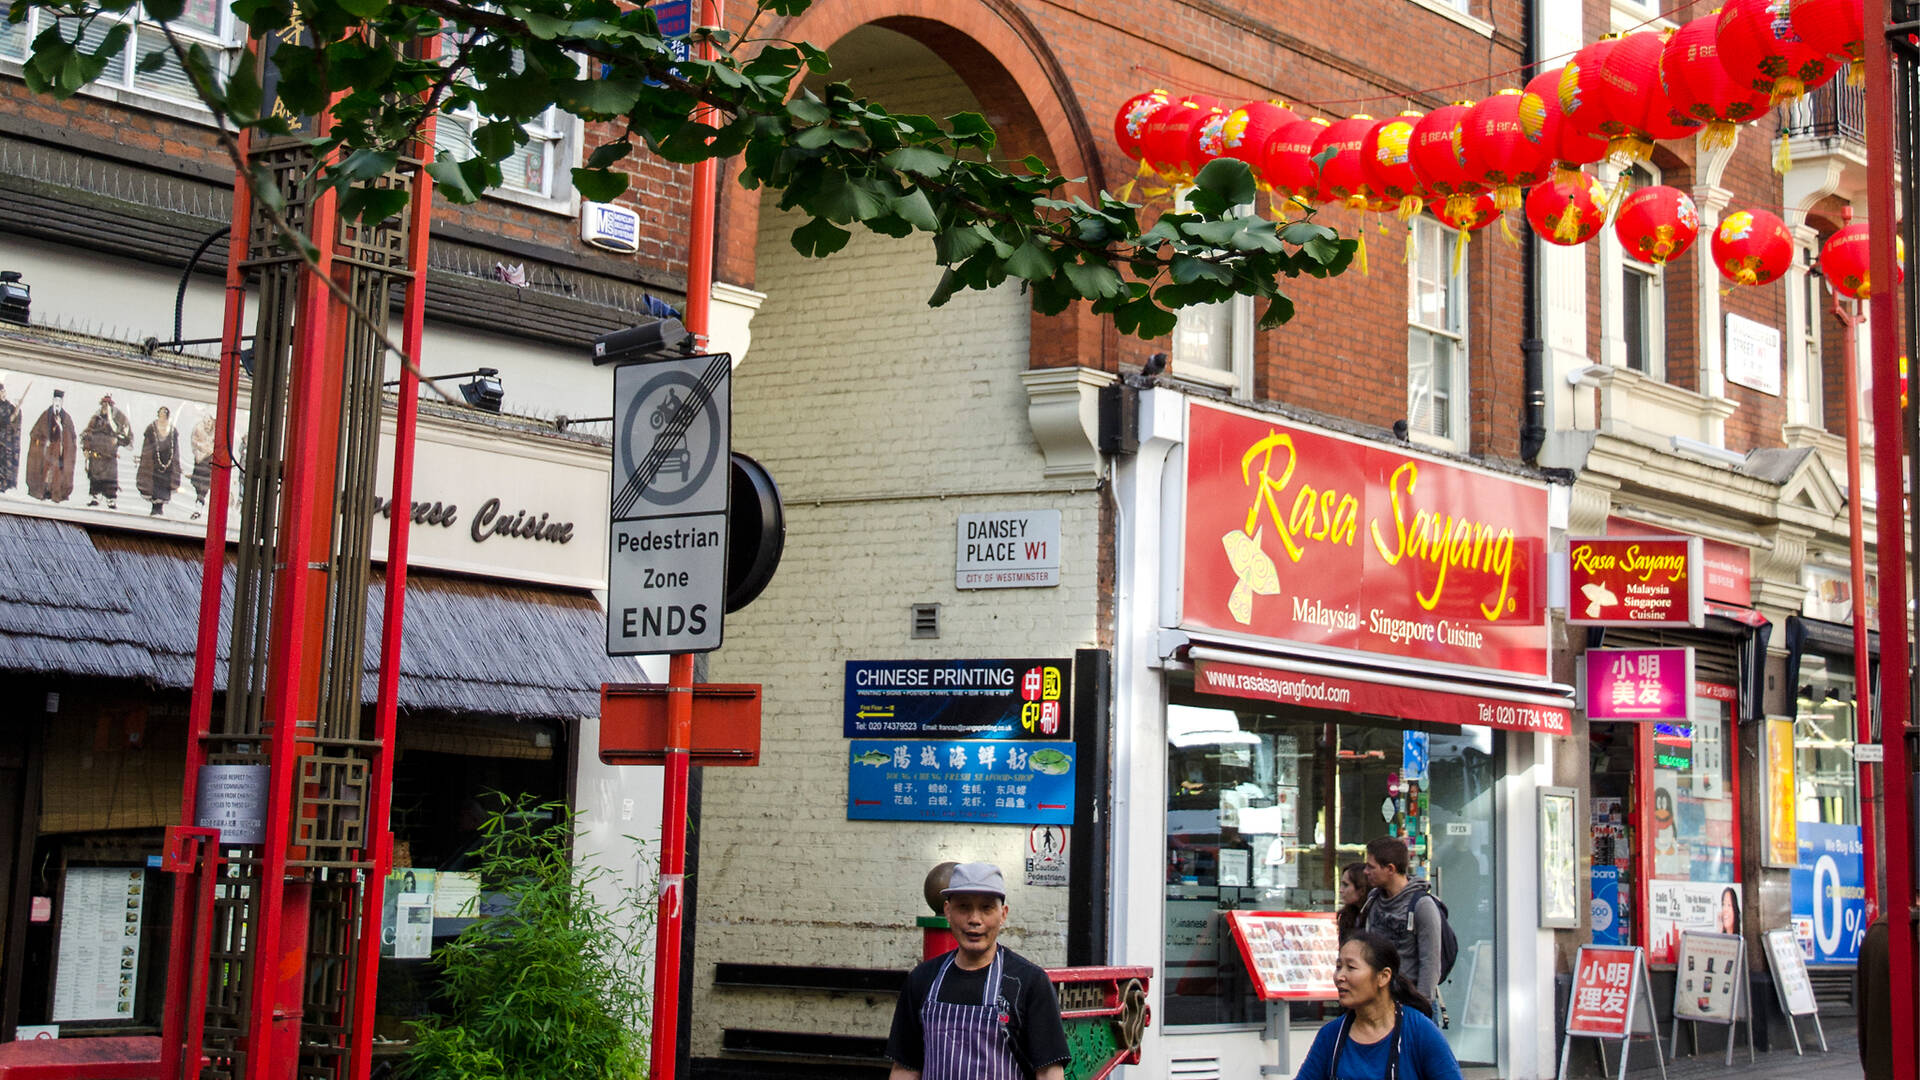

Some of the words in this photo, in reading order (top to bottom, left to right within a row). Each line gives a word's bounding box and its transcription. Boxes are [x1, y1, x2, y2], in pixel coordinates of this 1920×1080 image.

[471, 498, 574, 544] Cuisine
[967, 519, 1028, 539] DANSEY
[1241, 428, 1359, 562] Rasa
[1370, 461, 1515, 622] Sayang
[618, 527, 719, 552] Pedestrian
[967, 542, 1015, 562] PLACE
[1024, 541, 1046, 560] W1
[1572, 545, 1615, 575] Rasa
[1619, 545, 1685, 581] Sayang
[643, 568, 689, 589] Zone
[966, 574, 982, 583] CITY
[984, 574, 992, 582] OF
[996, 572, 1049, 582] WESTMINSTER
[1627, 584, 1669, 595] Malaysia
[1624, 597, 1671, 609] Singapore
[1629, 609, 1666, 620] Cuisine
[622, 604, 707, 638] ENDS
[1292, 597, 1358, 633] Malaysia
[1369, 609, 1434, 644] Singapore
[1437, 619, 1483, 649] Cuisine
[856, 669, 929, 686] CHINESE
[933, 668, 1014, 686] PRINTING
[1612, 654, 1660, 679] 小明
[1206, 671, 1350, 703] www.rasasayangfood.com
[1612, 680, 1662, 705] 美发
[868, 722, 882, 731] 020
[883, 722, 917, 731] 74379523
[1021, 701, 1059, 734] 印刷
[1478, 703, 1494, 722] Tel:
[1496, 706, 1515, 724] 020
[1516, 709, 1540, 727] 7734
[1543, 711, 1564, 729] 1382
[1028, 873, 1066, 881] Pedestrians
[1582, 960, 1630, 987] 小明
[1577, 987, 1628, 1014] 理发
